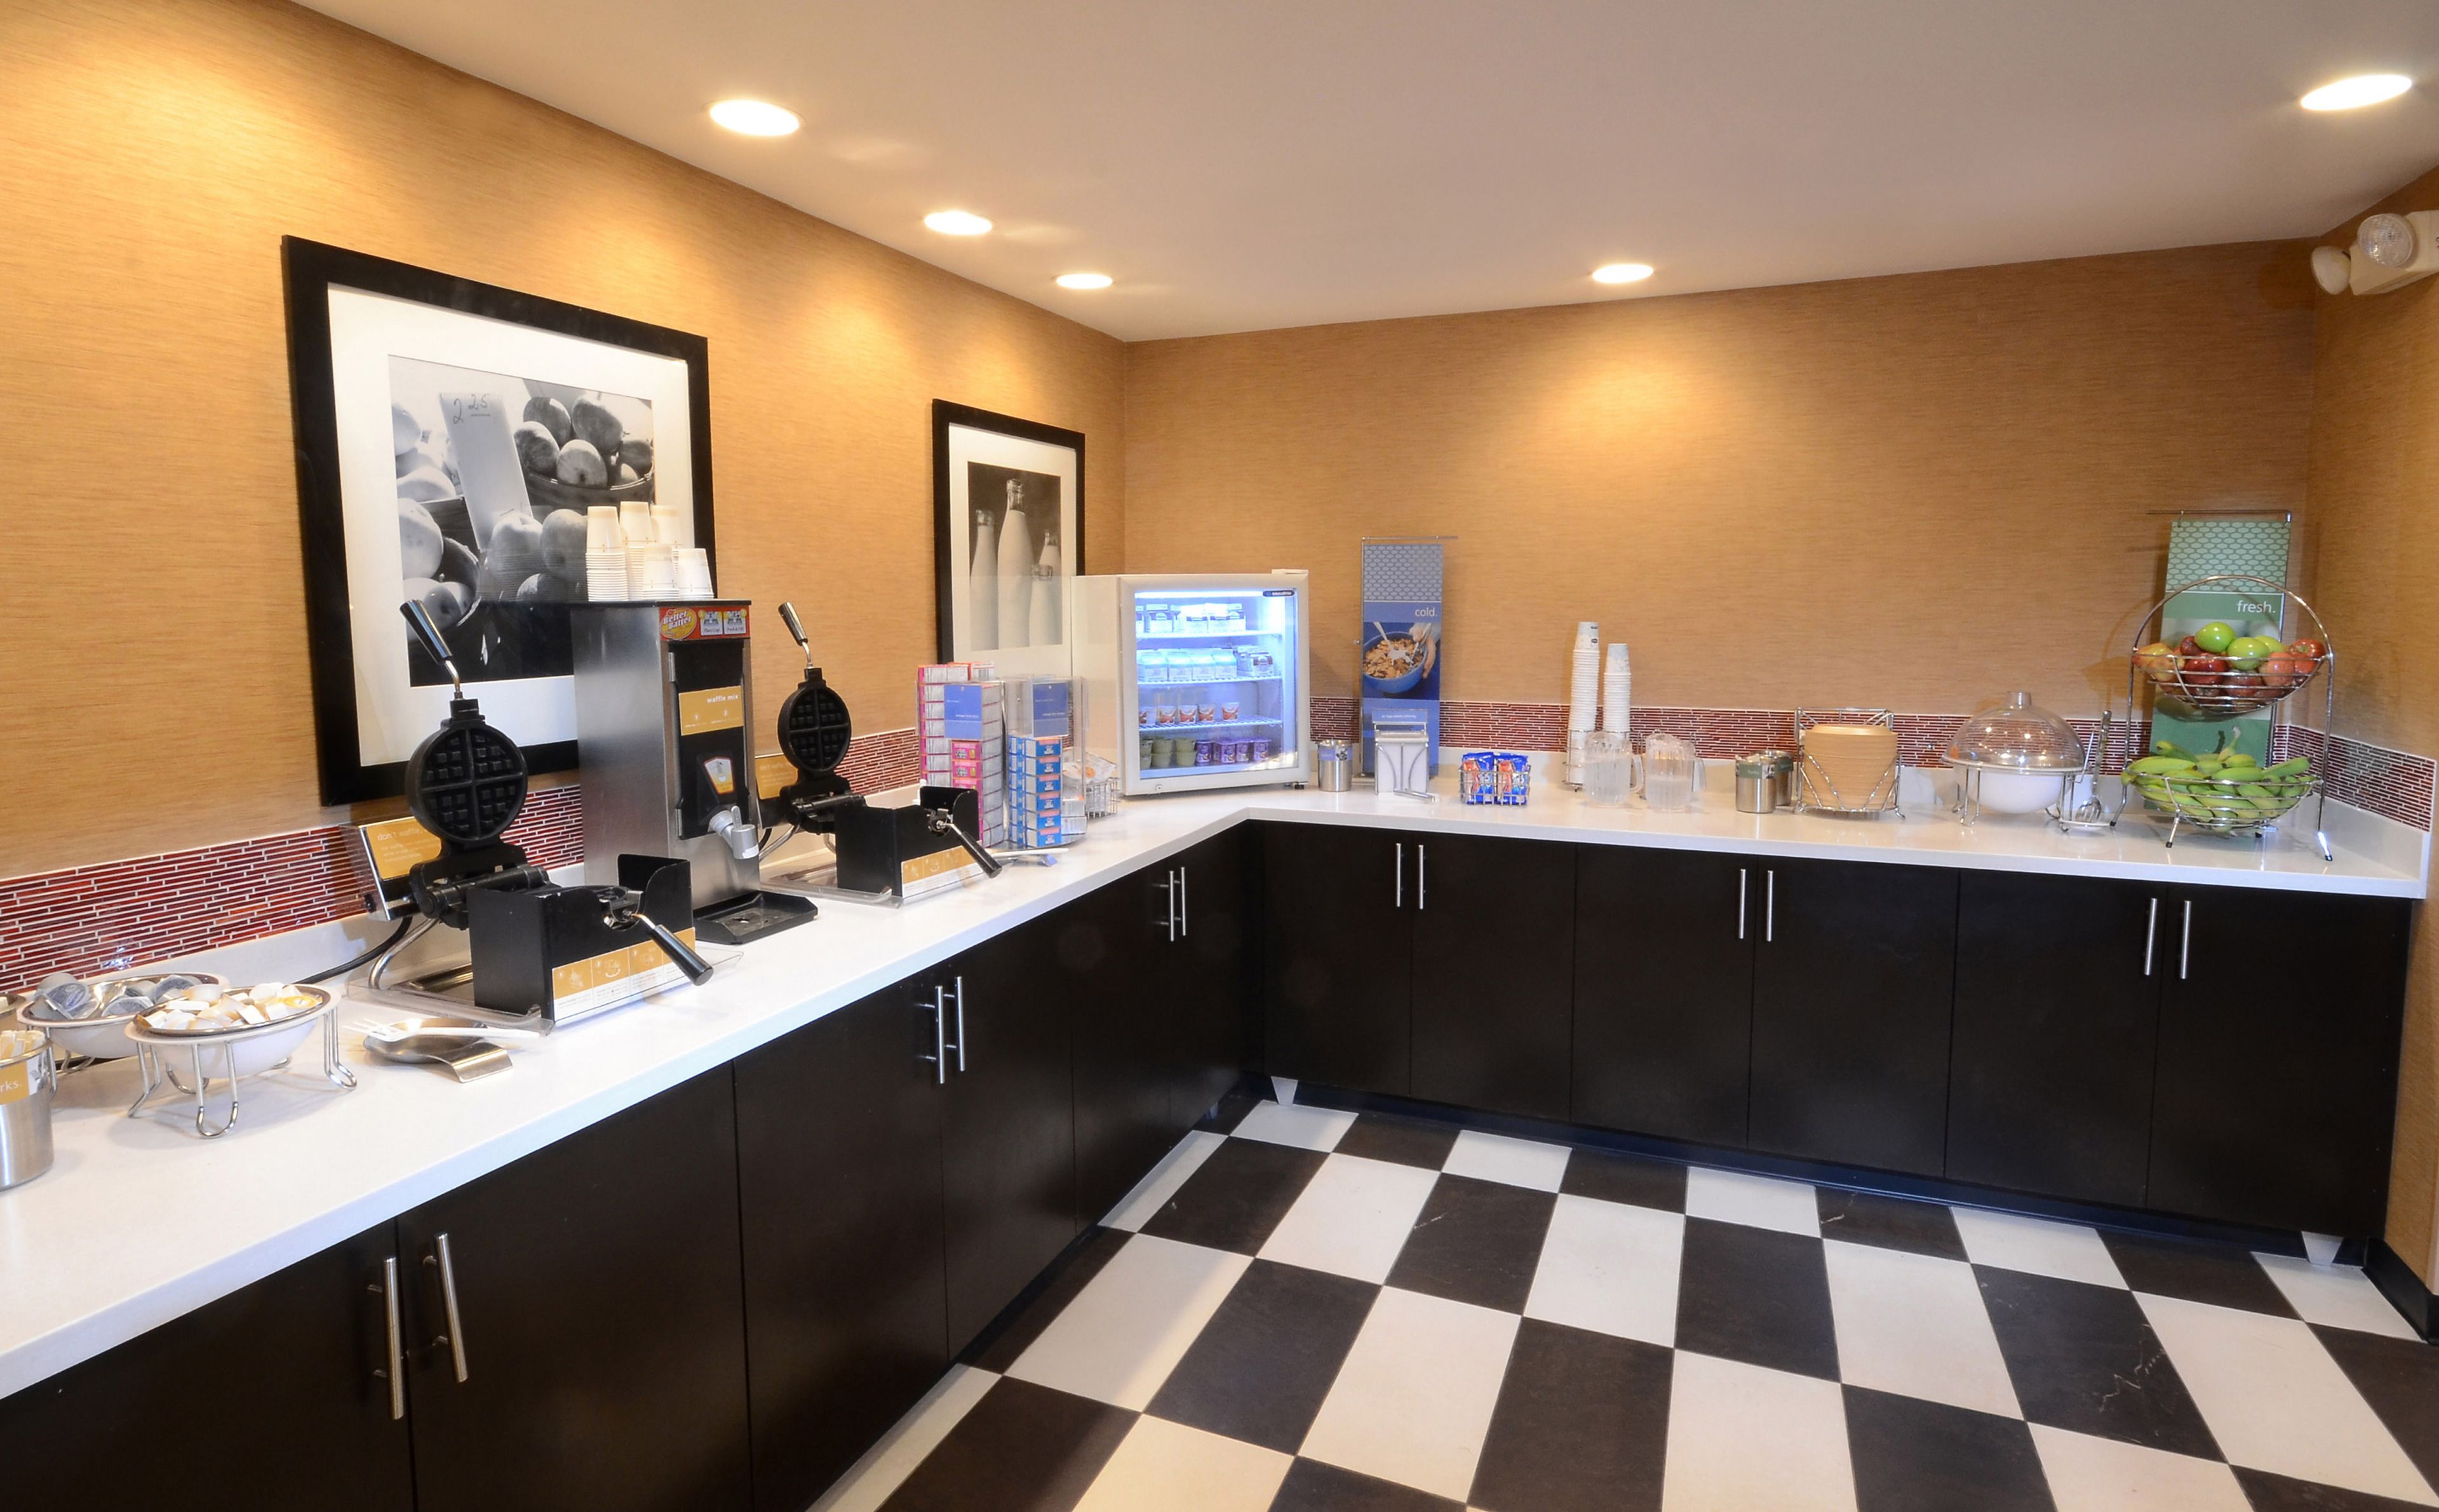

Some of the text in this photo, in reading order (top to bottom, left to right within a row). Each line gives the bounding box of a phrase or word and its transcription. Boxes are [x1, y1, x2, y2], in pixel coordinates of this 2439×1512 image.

[452, 398, 464, 425] 2
[1414, 606, 1438, 617] cold.
[2236, 599, 2276, 613] fresh.
[663, 610, 687, 625] Better
[668, 616, 692, 629] Batter
[706, 695, 726, 704] waffle
[377, 831, 397, 841] don't
